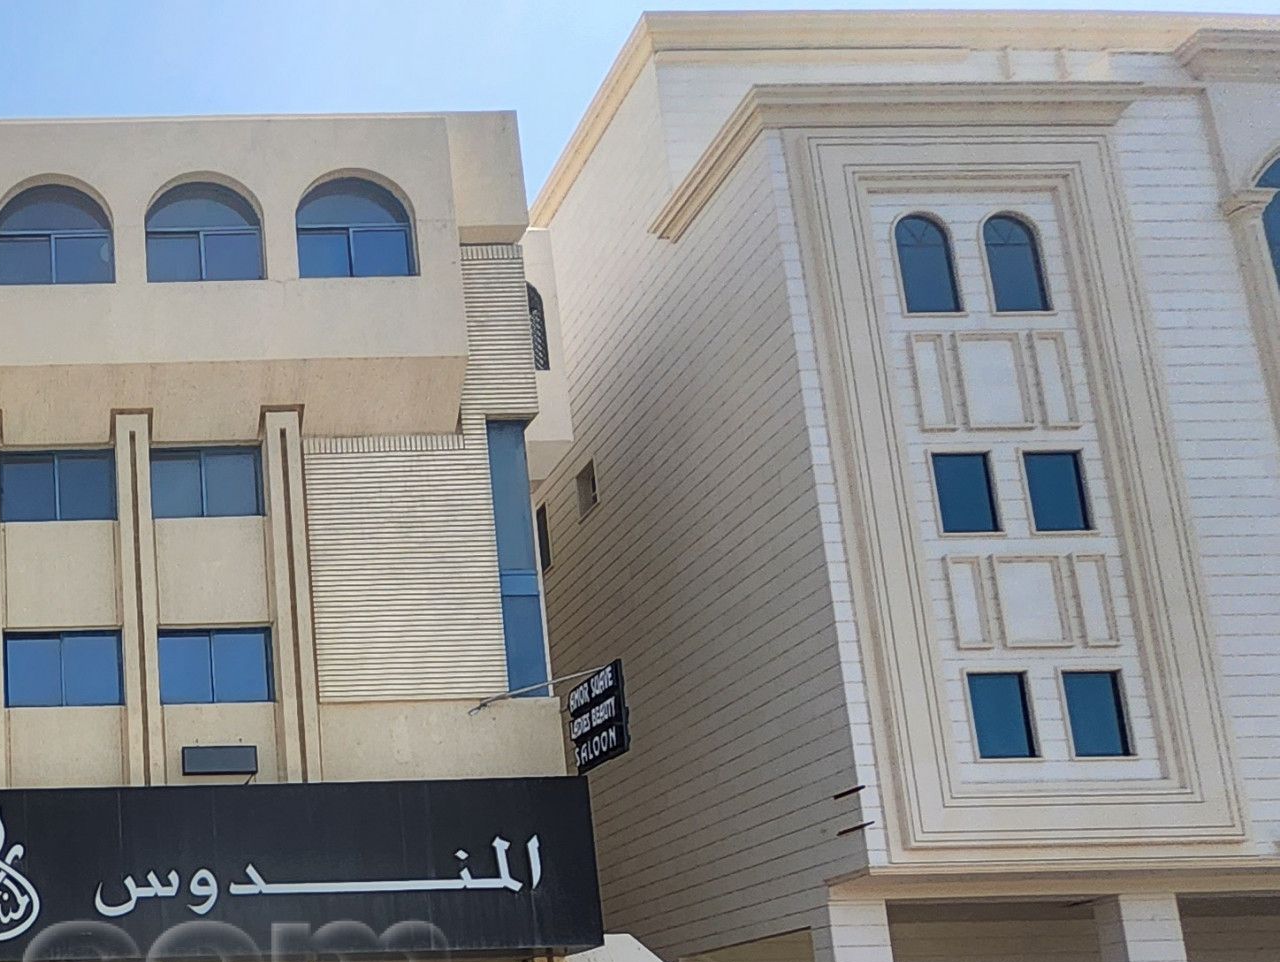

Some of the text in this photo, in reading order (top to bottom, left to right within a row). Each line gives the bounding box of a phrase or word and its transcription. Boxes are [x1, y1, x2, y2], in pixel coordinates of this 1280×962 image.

[591, 695, 616, 727] BEAUTY
[575, 725, 617, 767] SALOON
[94, 834, 543, 917] المندوس
